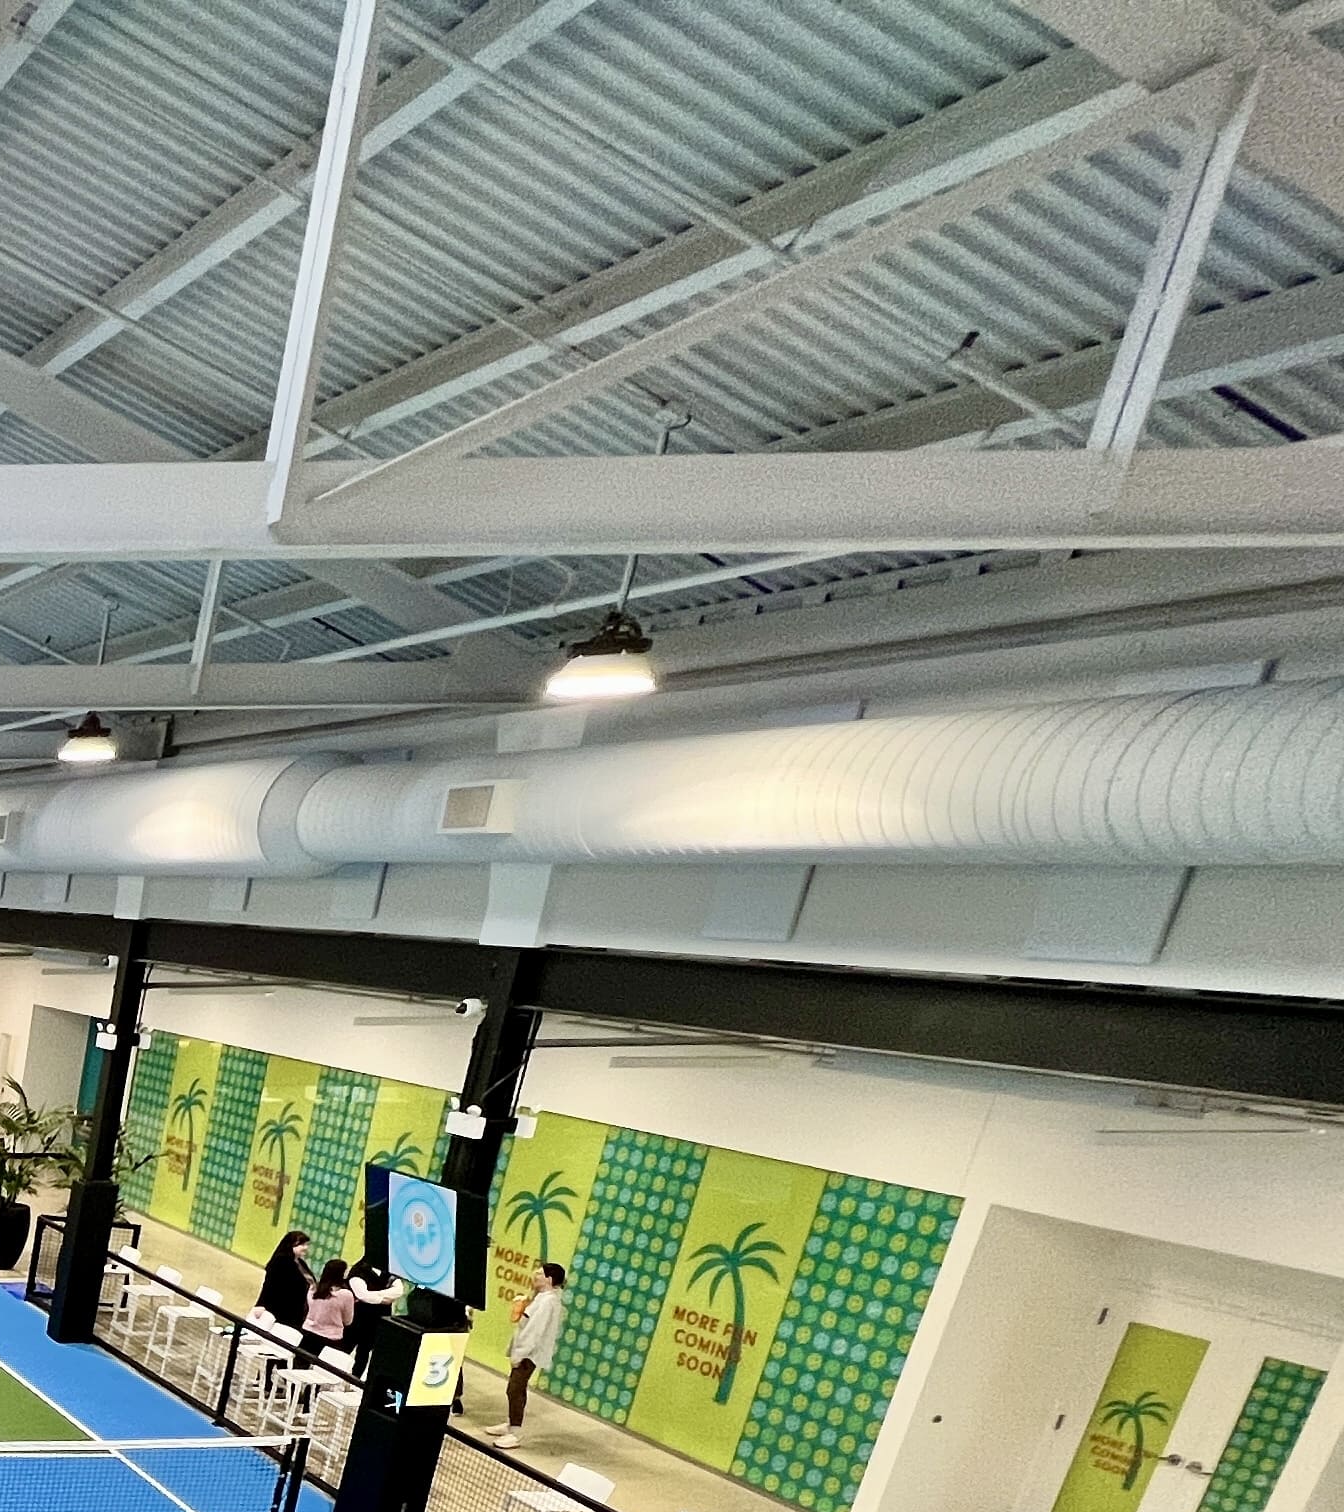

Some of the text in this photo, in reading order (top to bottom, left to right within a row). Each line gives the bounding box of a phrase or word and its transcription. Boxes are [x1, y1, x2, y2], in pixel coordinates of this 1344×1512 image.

[494, 1246, 529, 1268] MORE
[495, 1265, 534, 1291] COMIN
[673, 1306, 719, 1333] MORE
[422, 1355, 454, 1388] 3
[677, 1352, 725, 1381] SOON
